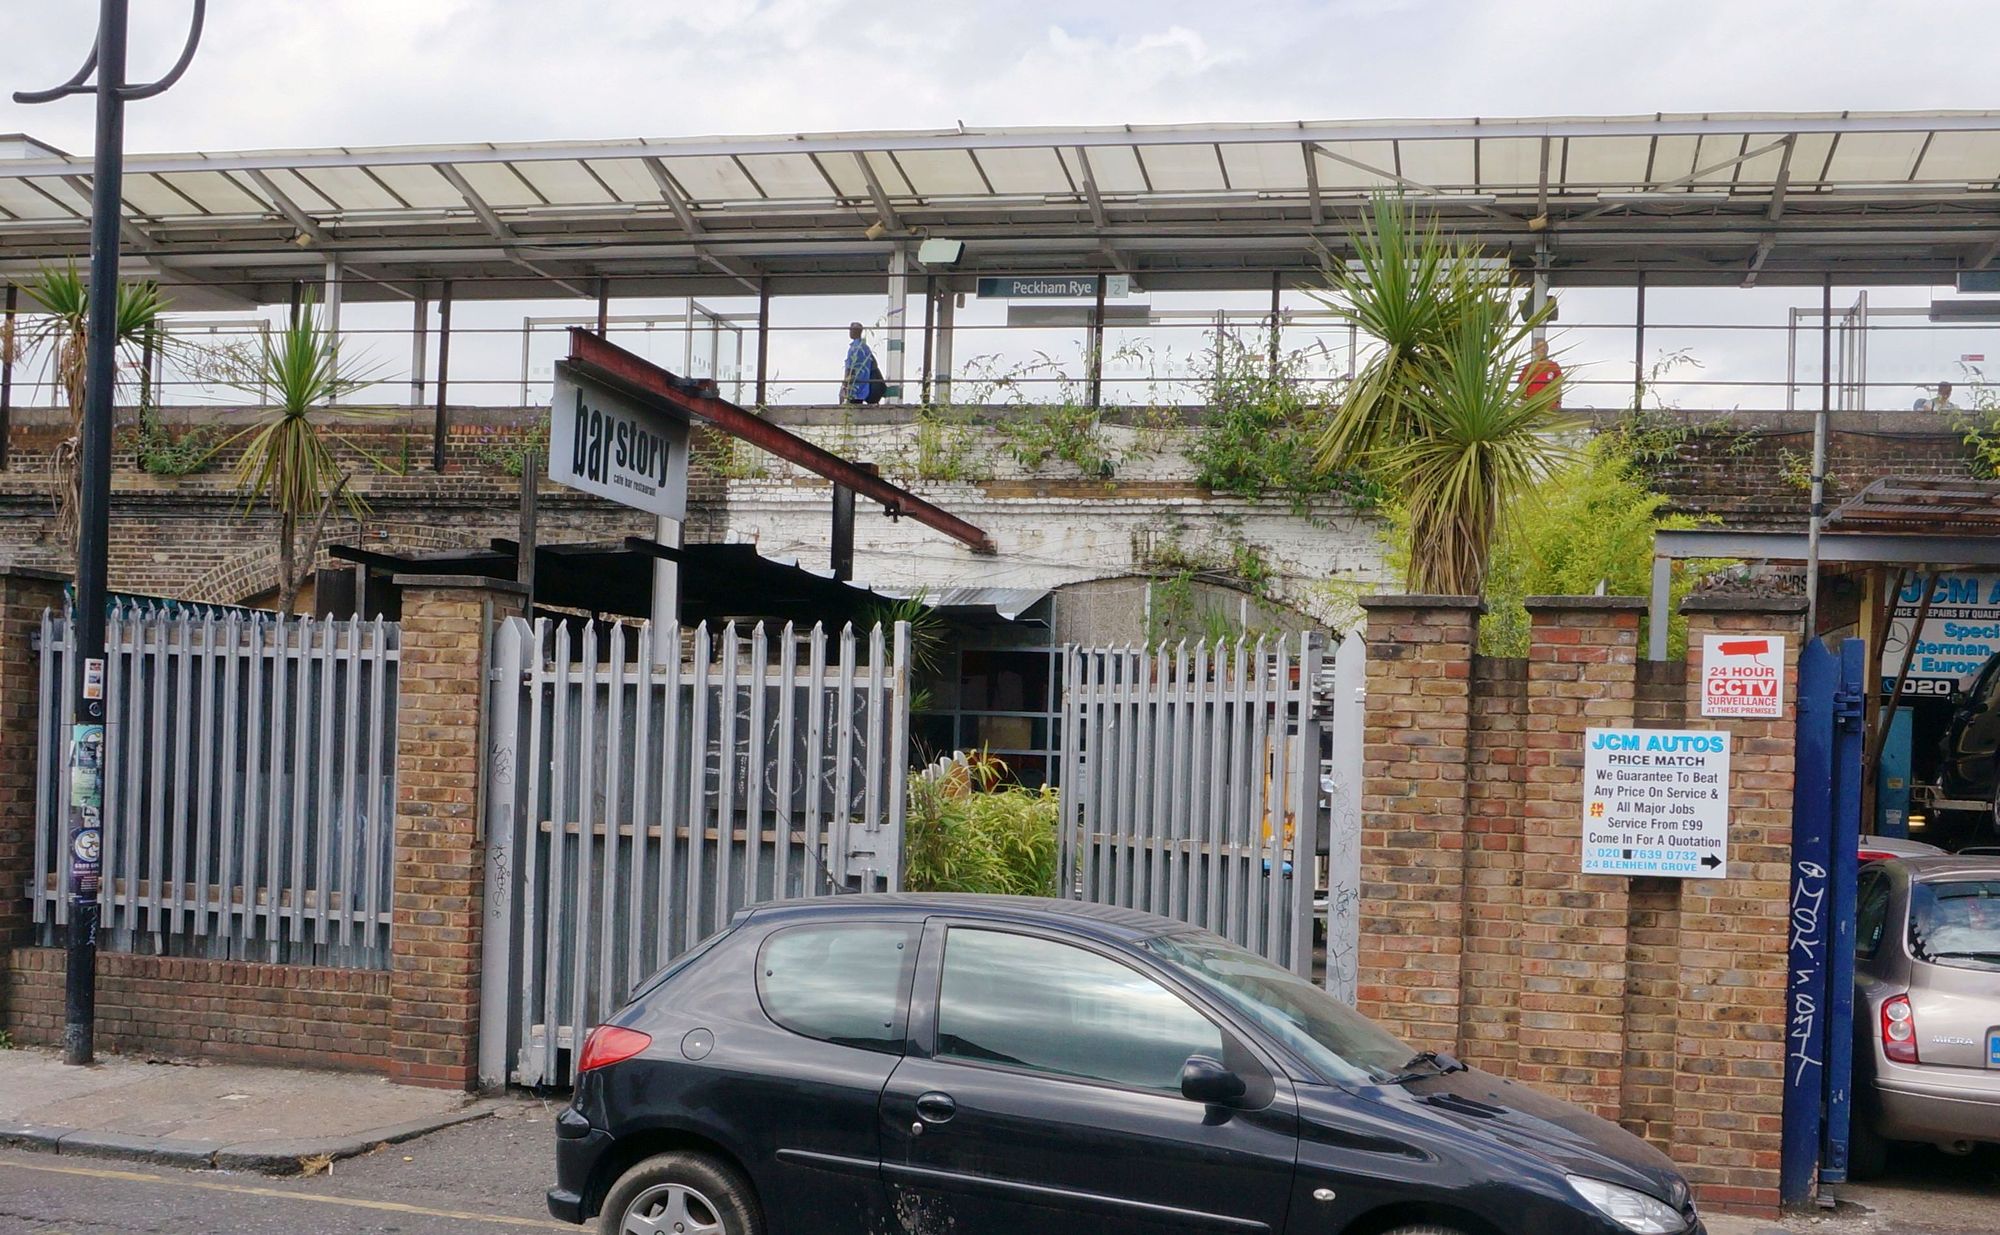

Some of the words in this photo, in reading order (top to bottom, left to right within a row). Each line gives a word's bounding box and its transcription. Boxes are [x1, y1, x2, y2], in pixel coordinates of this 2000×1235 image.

[1013, 281, 1066, 294] Peckham
[1069, 281, 1092, 296] Rye
[1113, 284, 1121, 295] 2
[1901, 573, 1979, 605] JCM
[1926, 609, 1957, 618] EPAIRS
[1959, 609, 1970, 618] BY
[1710, 667, 1727, 676] 24
[1732, 667, 1774, 677] HOUR
[1922, 657, 1984, 676] Europ
[1709, 680, 1775, 695] CCTV
[1902, 680, 1951, 694] 020
[1707, 696, 1776, 706] SURVEILLANCE
[1717, 706, 1739, 714] THESE
[1741, 707, 1776, 715] PREMISES
[1592, 734, 1640, 750] JCM
[1646, 735, 1724, 752] AUTOS
[1608, 754, 1650, 765] PRICE
[1655, 756, 1705, 766] MATCH
[1596, 769, 1613, 780] We
[1616, 770, 1673, 782] Guarantee
[1677, 771, 1690, 782] To
[1693, 772, 1718, 783] Beat
[1594, 785, 1614, 798] Any
[1617, 786, 1645, 797] Price
[1649, 787, 1663, 798] On
[1667, 787, 1707, 799] Service
[1710, 788, 1719, 799] &
[1617, 802, 1631, 813] All
[1634, 802, 1667, 816] Major
[1669, 804, 1695, 815] Jobs
[1607, 817, 1647, 829] Service
[1651, 819, 1678, 830] From
[1682, 820, 1703, 831] £99
[1589, 832, 1619, 844] Come
[1622, 834, 1633, 844] In
[1636, 834, 1654, 845] For
[1657, 835, 1665, 845] A
[1668, 835, 1721, 847] Quotation
[1597, 848, 1620, 858] 020
[1632, 849, 1662, 860] 7639
[1666, 850, 1697, 861] 0732
[1585, 860, 1599, 868] 24
[1602, 861, 1657, 870] BLENHEIM
[1661, 861, 1697, 872] GROVE
[1932, 1035, 1975, 1045] MICRA
